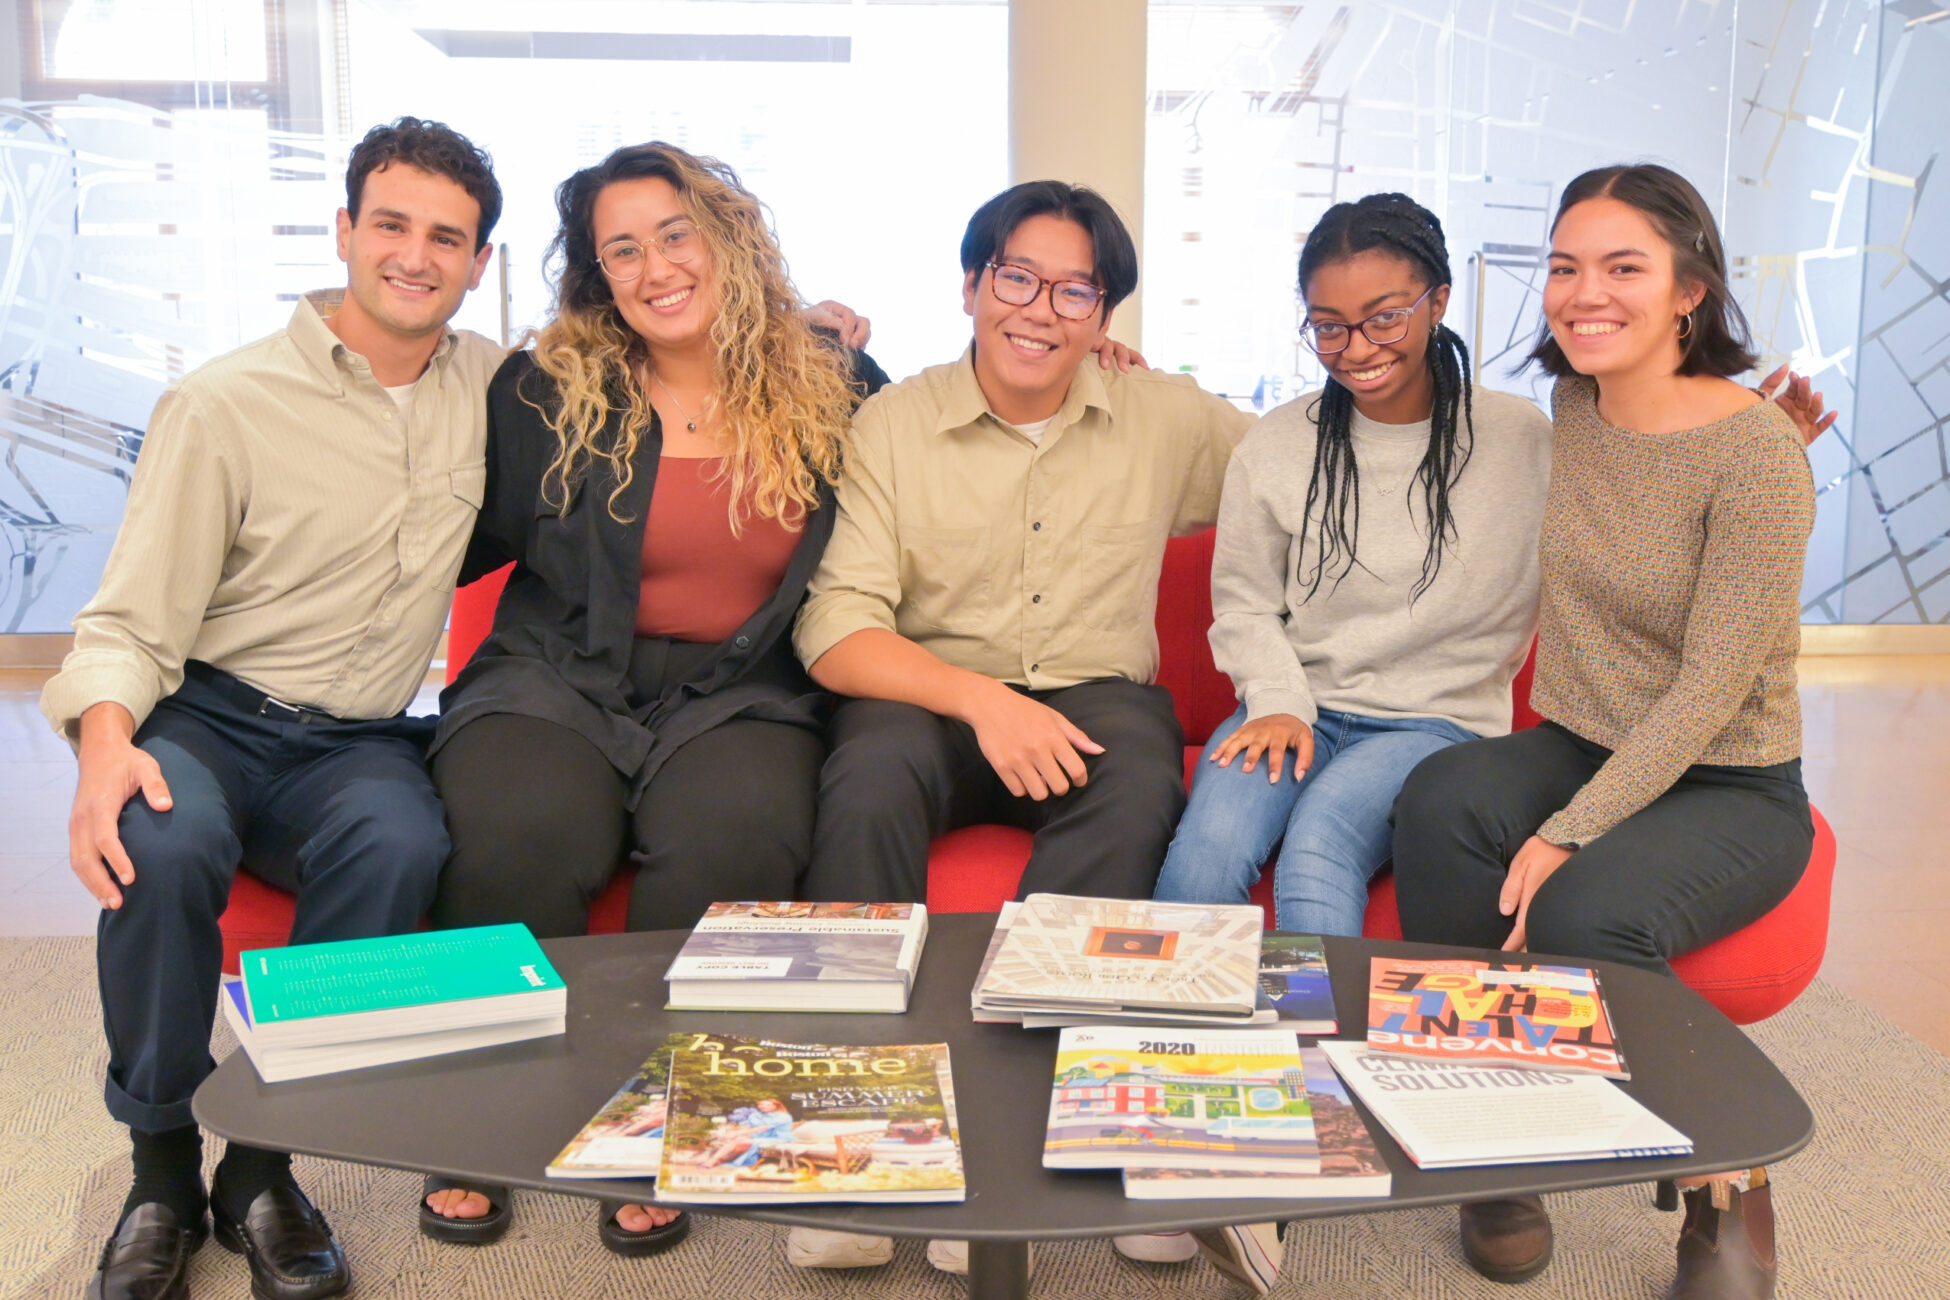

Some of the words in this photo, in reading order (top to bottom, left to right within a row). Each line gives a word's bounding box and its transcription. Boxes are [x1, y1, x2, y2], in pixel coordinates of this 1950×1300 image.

[702, 925, 802, 933] Preservation
[1368, 1010, 1613, 1050] TALENT
[1138, 1040, 1196, 1057] 2020
[1367, 1030, 1617, 1064] convene
[702, 1051, 907, 1077] home
[1371, 1068, 1573, 1092] SOLUTIONS
[790, 1089, 926, 1101] SUMMER
[802, 1097, 918, 1108] ESCAPE
